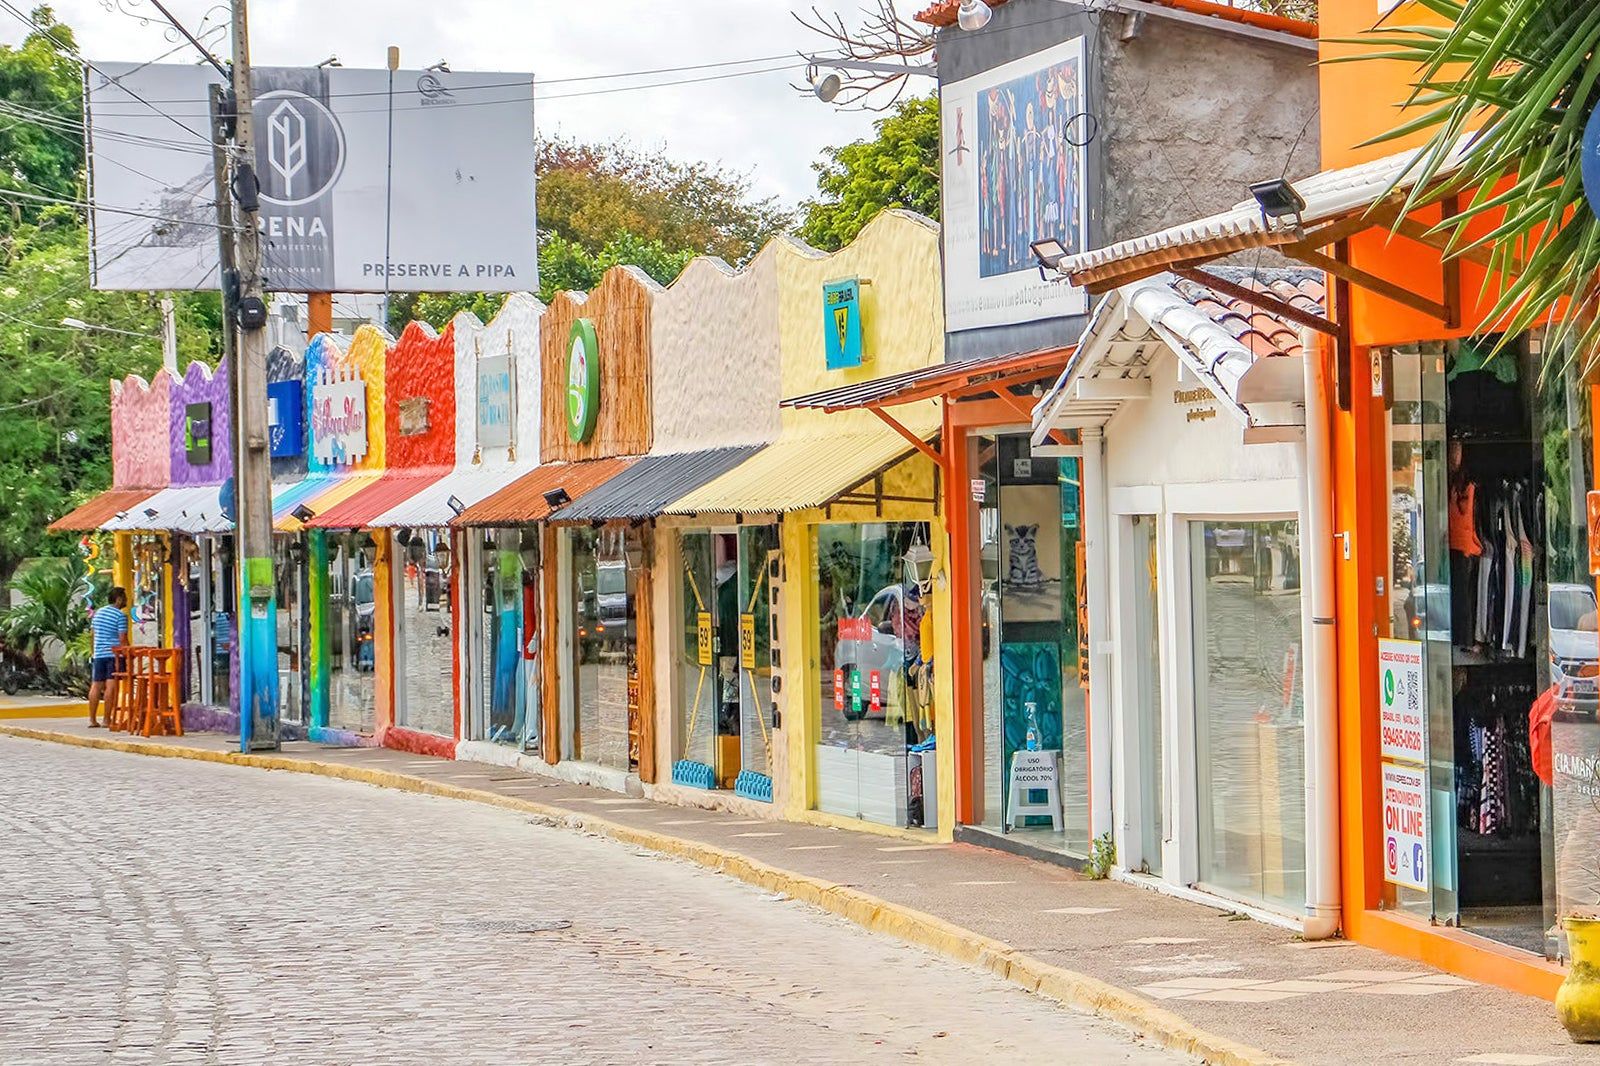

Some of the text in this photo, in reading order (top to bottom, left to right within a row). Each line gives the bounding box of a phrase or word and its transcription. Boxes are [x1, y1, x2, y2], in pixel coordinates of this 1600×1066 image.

[363, 264, 516, 278] PRESERVE A PIPA
[1385, 788, 1422, 807] ATENDIMENTO
[1385, 804, 1423, 837] ON LINE
